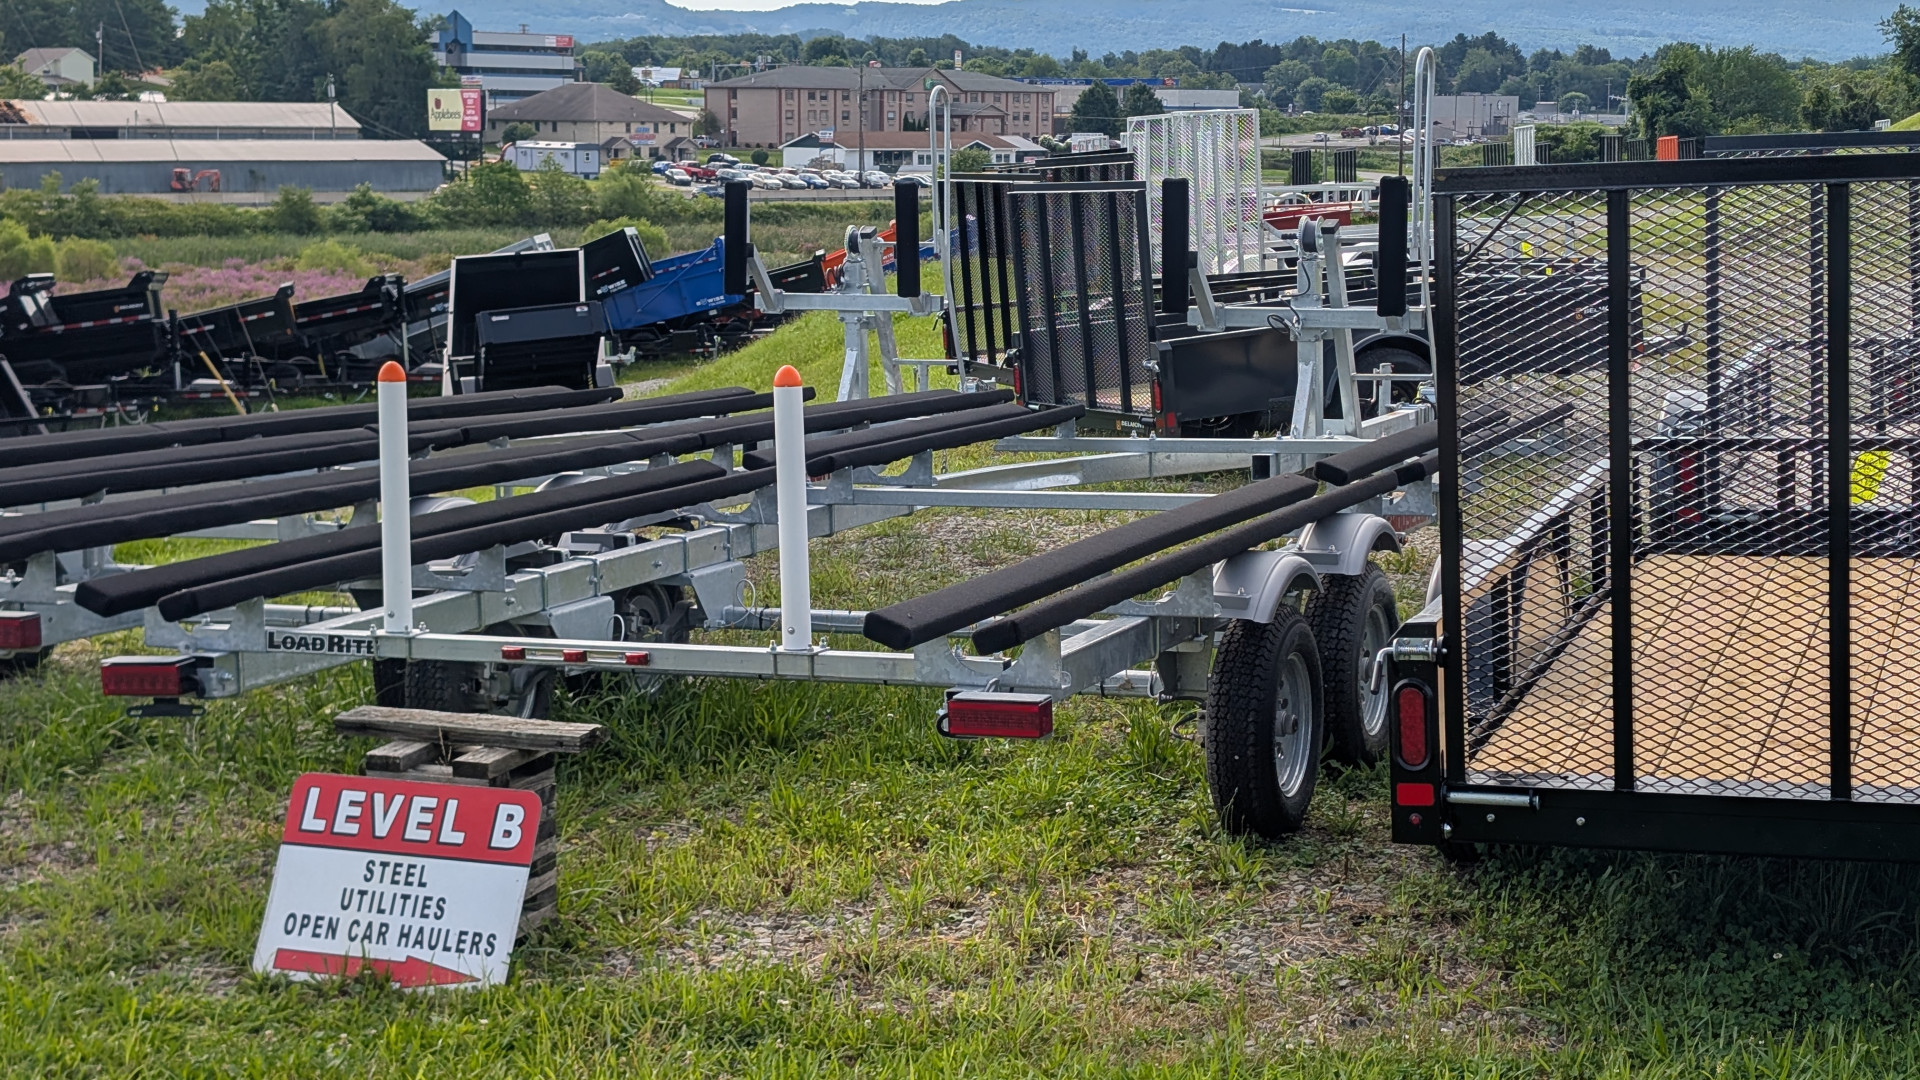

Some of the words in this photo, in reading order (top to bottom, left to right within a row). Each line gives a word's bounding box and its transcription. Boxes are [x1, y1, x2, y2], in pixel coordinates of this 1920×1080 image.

[299, 786, 466, 846] LEVEL
[488, 803, 525, 850] B
[363, 859, 428, 888] STEEL
[340, 887, 447, 921] UTILITIES
[283, 912, 340, 940] OPEN
[347, 919, 391, 946] CAR
[396, 924, 497, 957] HAULERS
